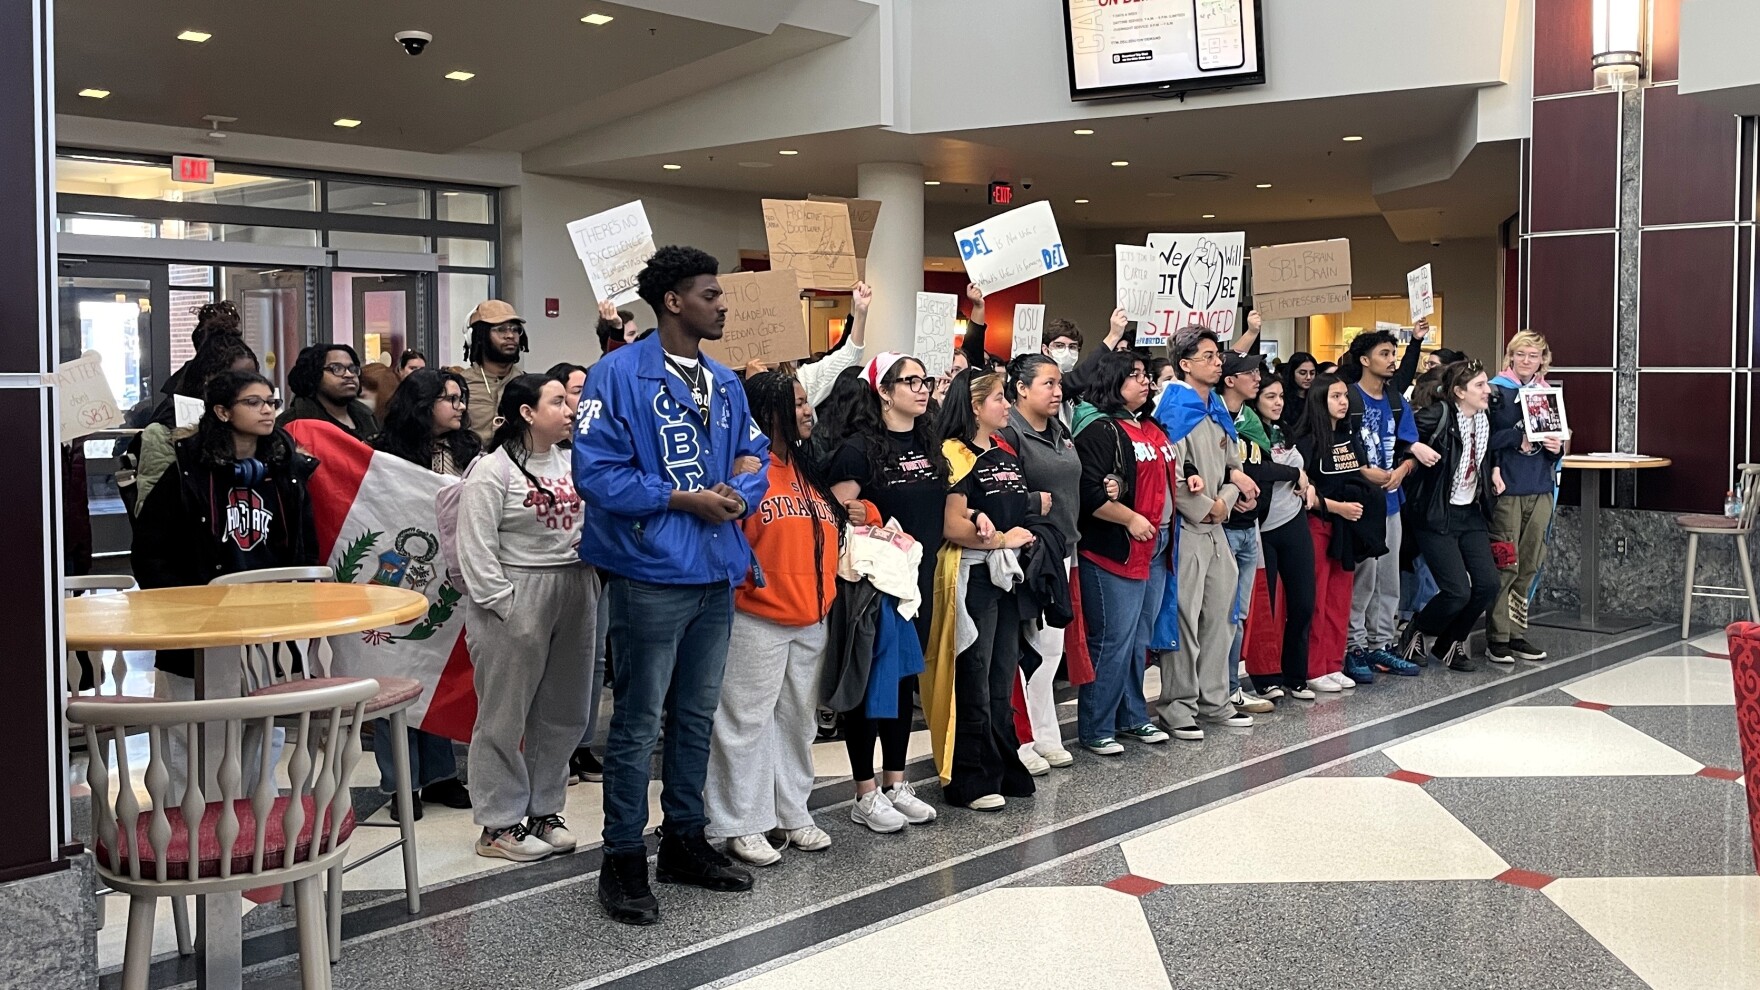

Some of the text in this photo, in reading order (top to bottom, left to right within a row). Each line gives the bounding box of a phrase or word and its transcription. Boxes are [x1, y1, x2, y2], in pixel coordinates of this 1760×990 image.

[181, 158, 208, 181] EXIT
[995, 186, 1010, 204] EXIT
[622, 214, 639, 231] NO
[960, 229, 993, 261] DEI
[1041, 244, 1064, 270] DEI
[1303, 250, 1335, 265] BRAIN
[1124, 264, 1148, 281] CARTER
[1304, 266, 1338, 282] DRAIN
[723, 282, 760, 303] HIO
[1221, 277, 1238, 298] BE
[758, 321, 786, 337] GOES
[1019, 308, 1038, 331] OSU
[725, 338, 773, 362] TO DIE
[577, 399, 602, 419] SPR
[578, 416, 590, 434] 4
[1333, 452, 1355, 464] STUDENT
